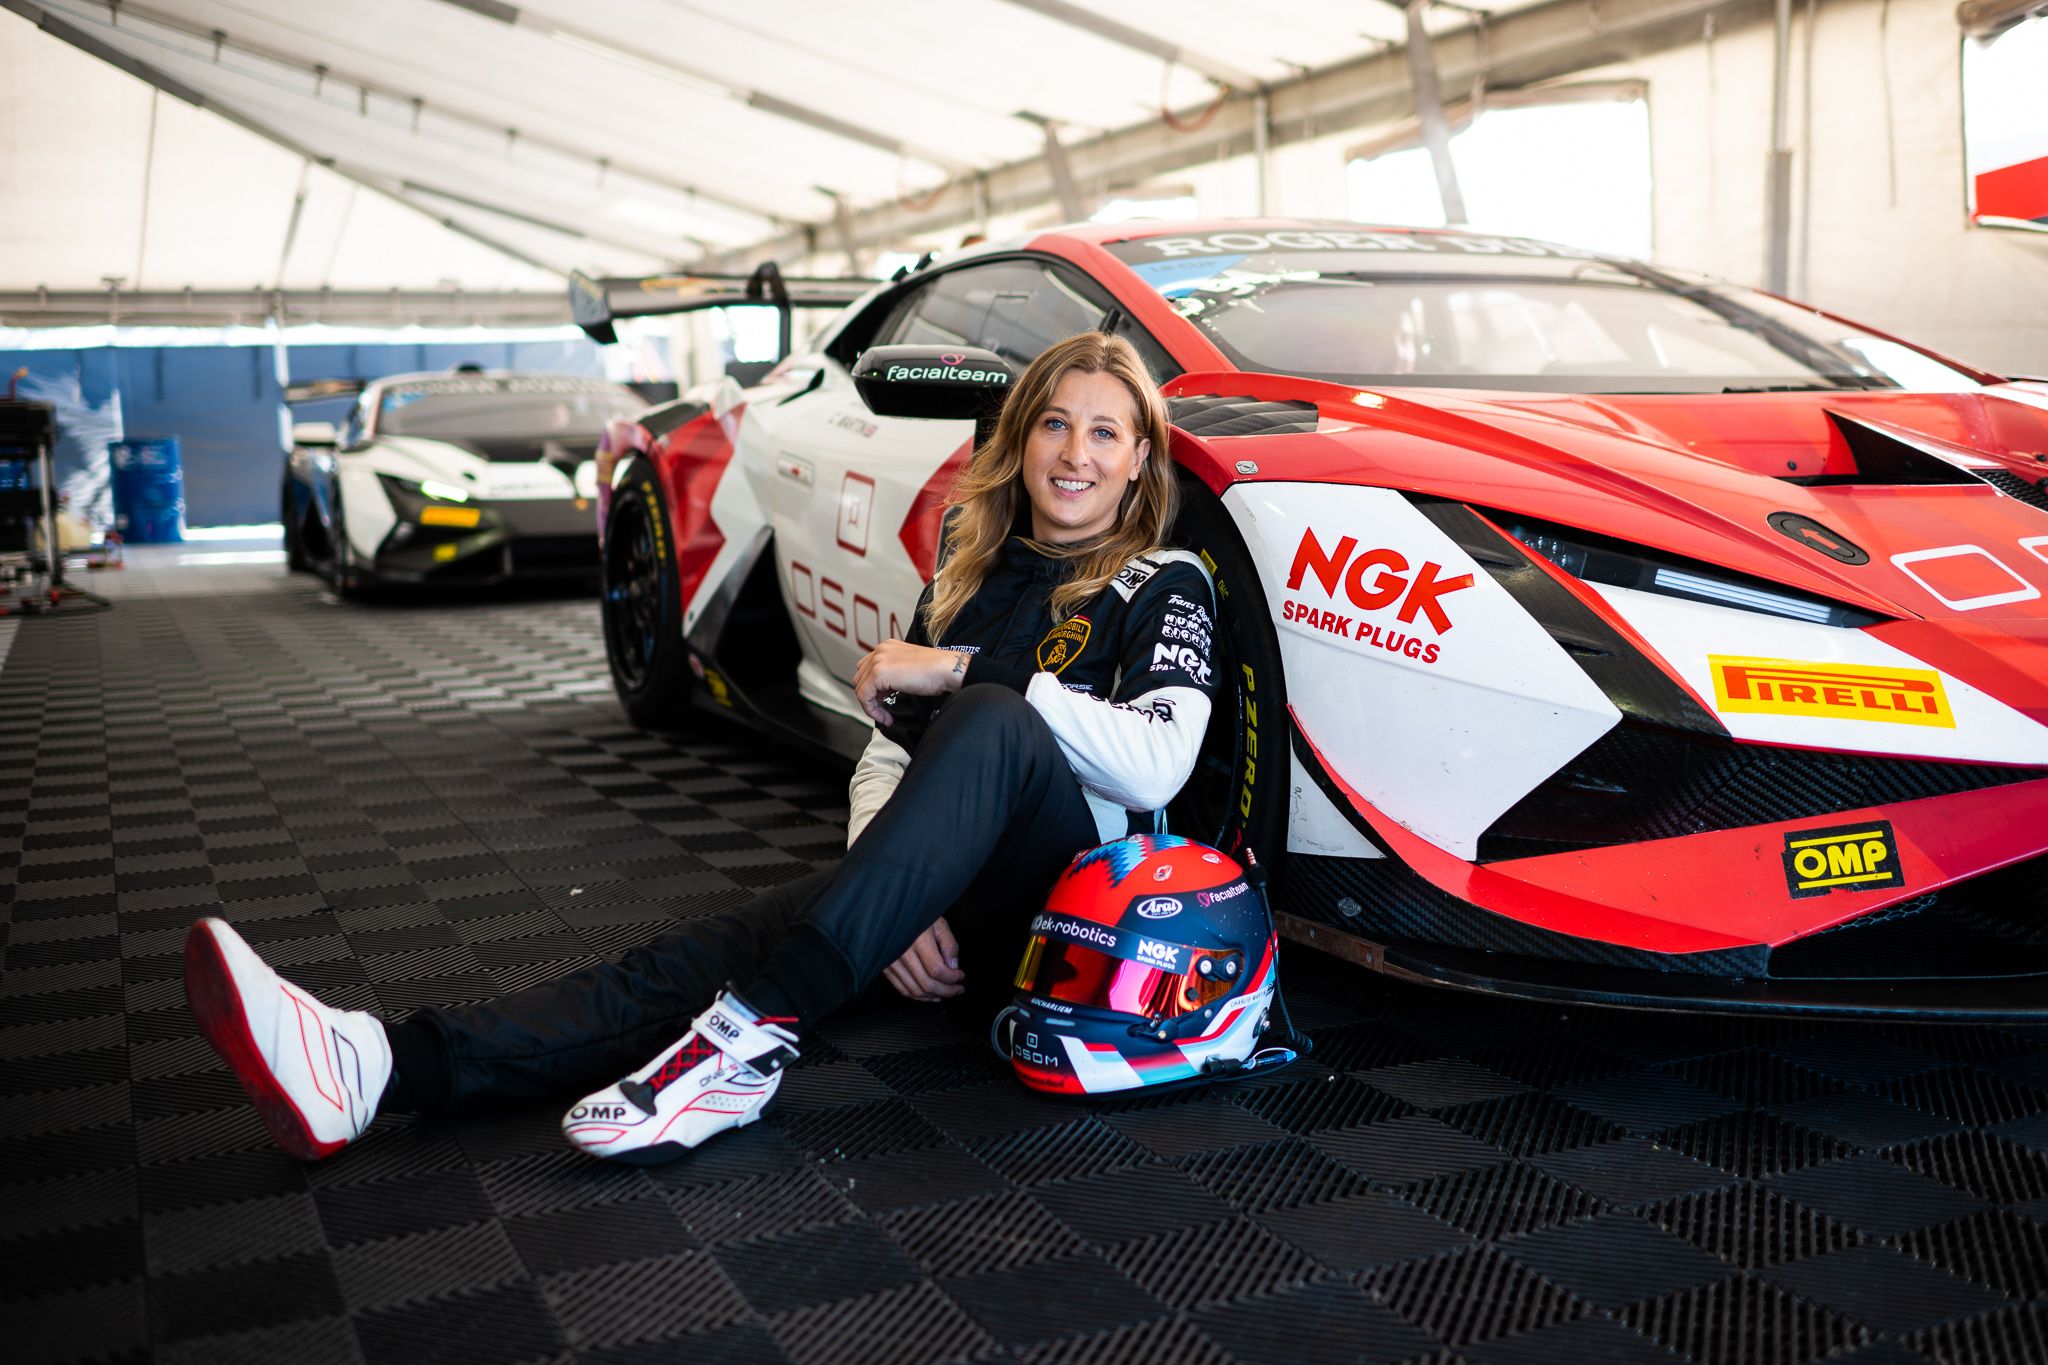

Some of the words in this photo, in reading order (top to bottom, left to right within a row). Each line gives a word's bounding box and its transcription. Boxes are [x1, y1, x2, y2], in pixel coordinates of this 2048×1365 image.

[1143, 231, 1438, 257] ROGER
[886, 365, 1008, 385] facialteam
[1286, 526, 1475, 636] NGK
[1168, 594, 1196, 610] Trans
[1164, 613, 1212, 648] HUMAN
[1188, 613, 1203, 624] Are
[1282, 600, 1353, 638] SPARK
[1355, 621, 1441, 664] PLUGS
[1152, 642, 1213, 687] NGK
[1061, 683, 1093, 692] ORSE
[1722, 665, 1939, 715] PIRELLI
[1793, 839, 1888, 879] OMP
[1209, 882, 1250, 903] facialteam
[1142, 899, 1178, 914] Arai
[1136, 955, 1156, 966] SPARK
[1156, 959, 1176, 970] PLUGS
[1137, 938, 1180, 964] NGK
[709, 1015, 740, 1039] OMP
[1015, 1044, 1058, 1068] OSOM
[570, 1105, 627, 1120] OMP
